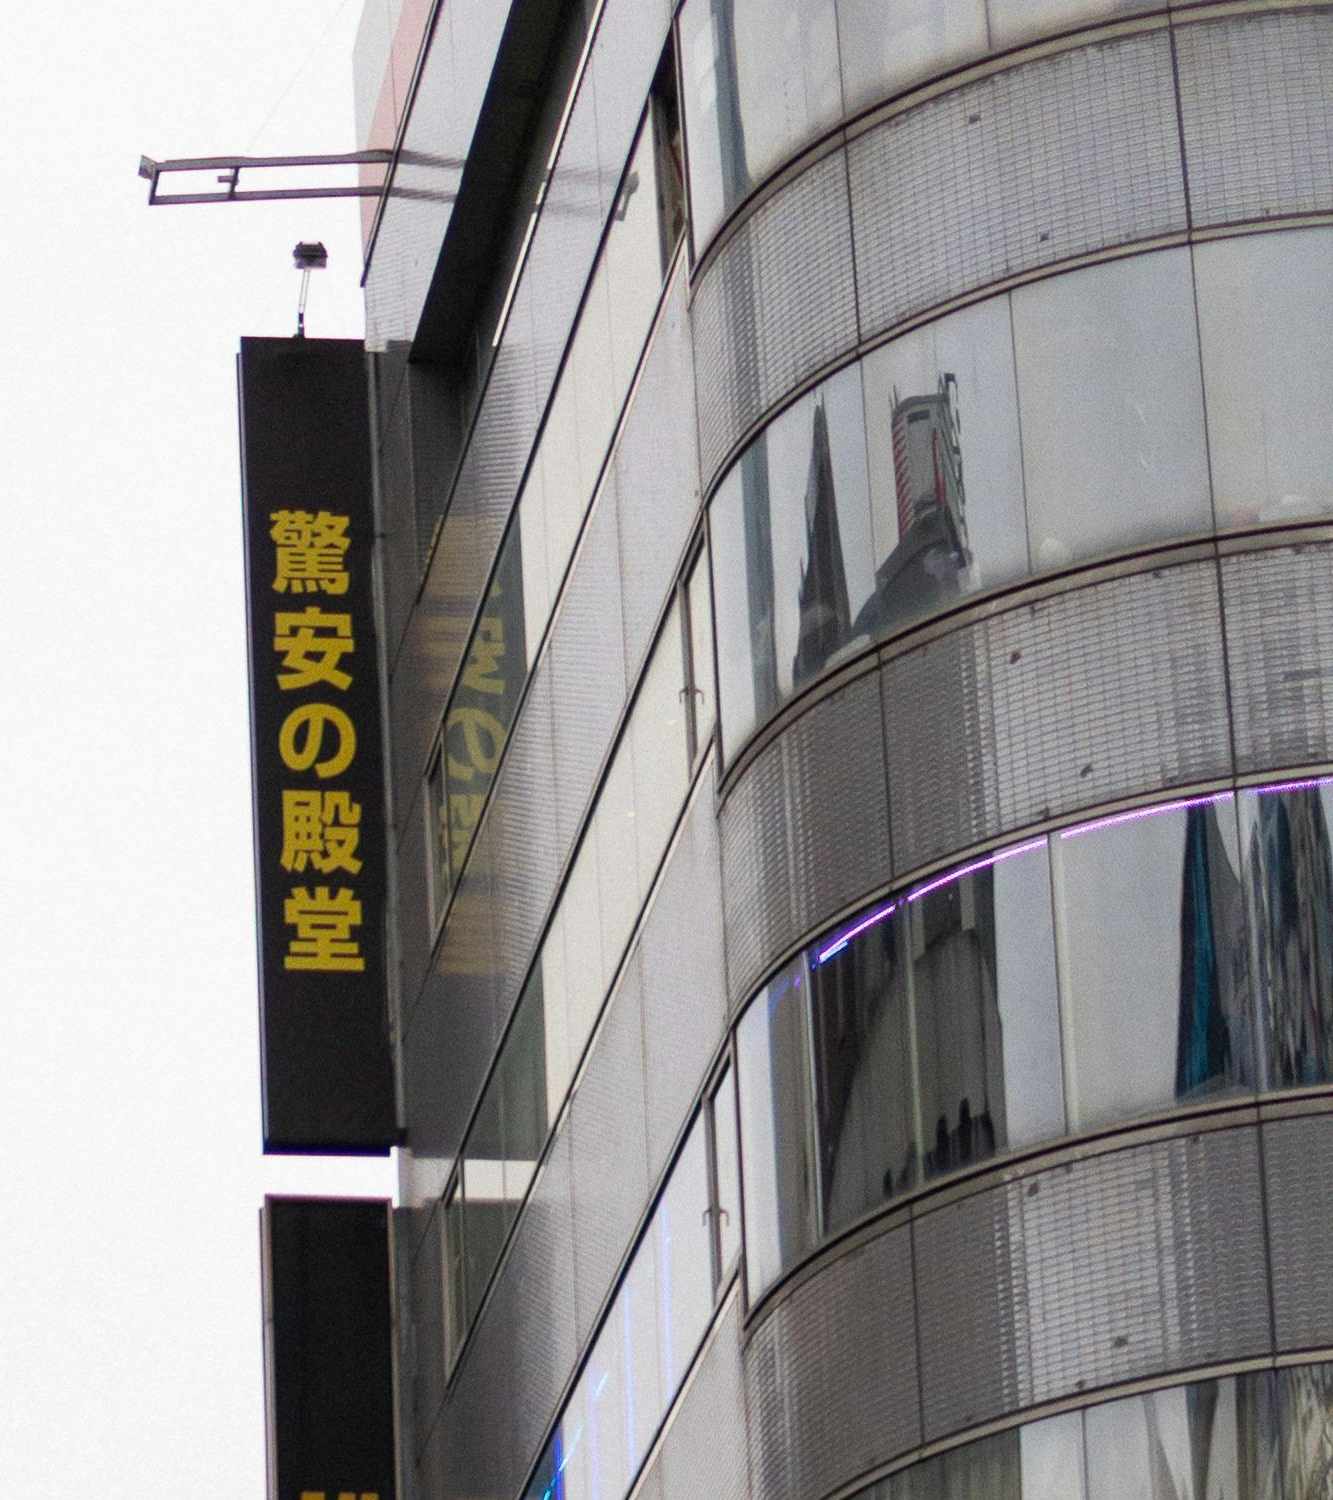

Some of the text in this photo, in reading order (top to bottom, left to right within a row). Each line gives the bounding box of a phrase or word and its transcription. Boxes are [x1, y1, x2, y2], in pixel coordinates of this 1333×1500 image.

[269, 509, 364, 972] 驚安の殿堂
